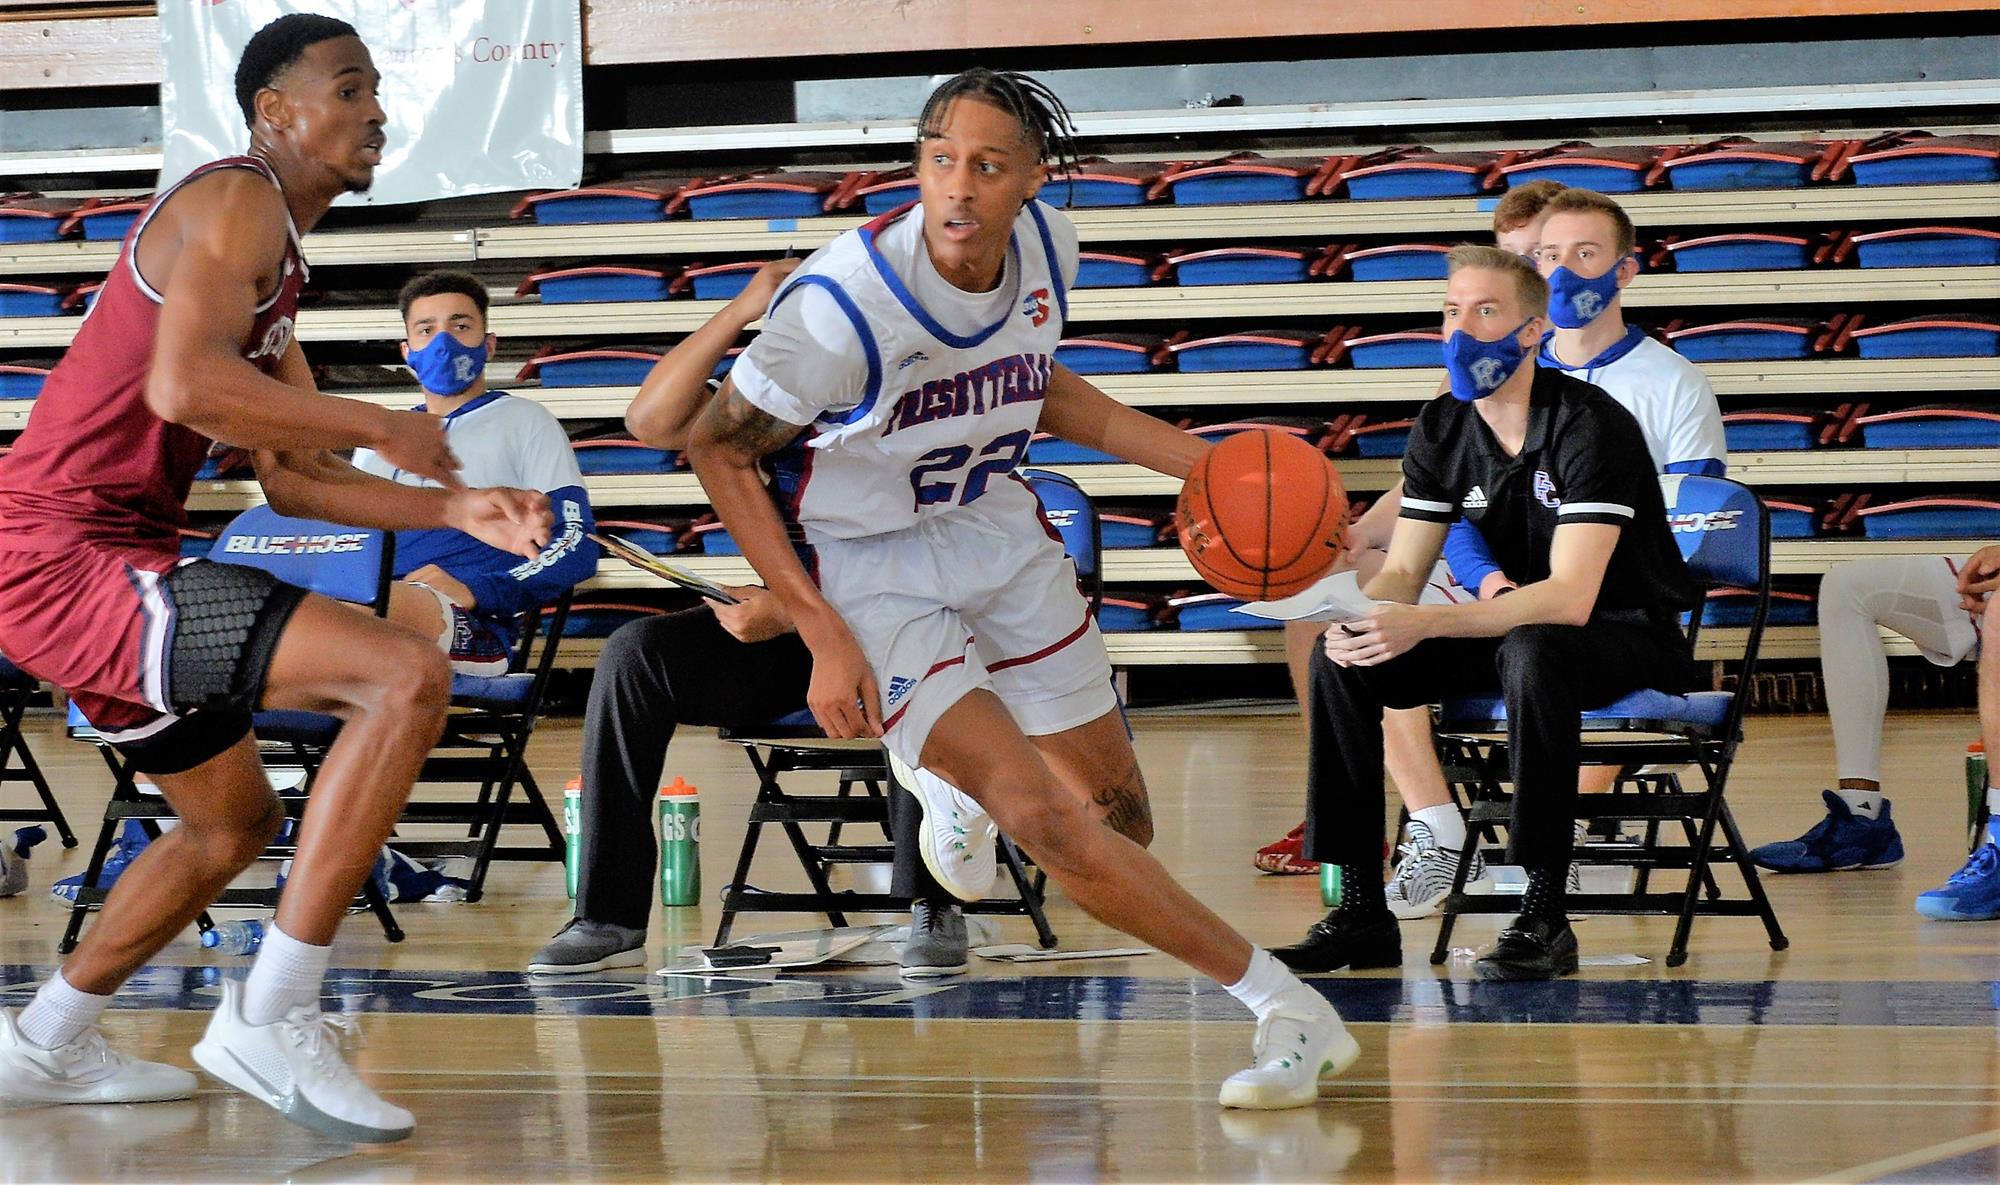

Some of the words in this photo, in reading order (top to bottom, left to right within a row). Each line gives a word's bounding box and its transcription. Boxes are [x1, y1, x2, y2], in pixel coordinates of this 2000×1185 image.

[1469, 356, 1507, 391] PC
[909, 428, 1032, 514] 22
[224, 535, 296, 555] BLUE
[294, 533, 371, 555] HOSE
